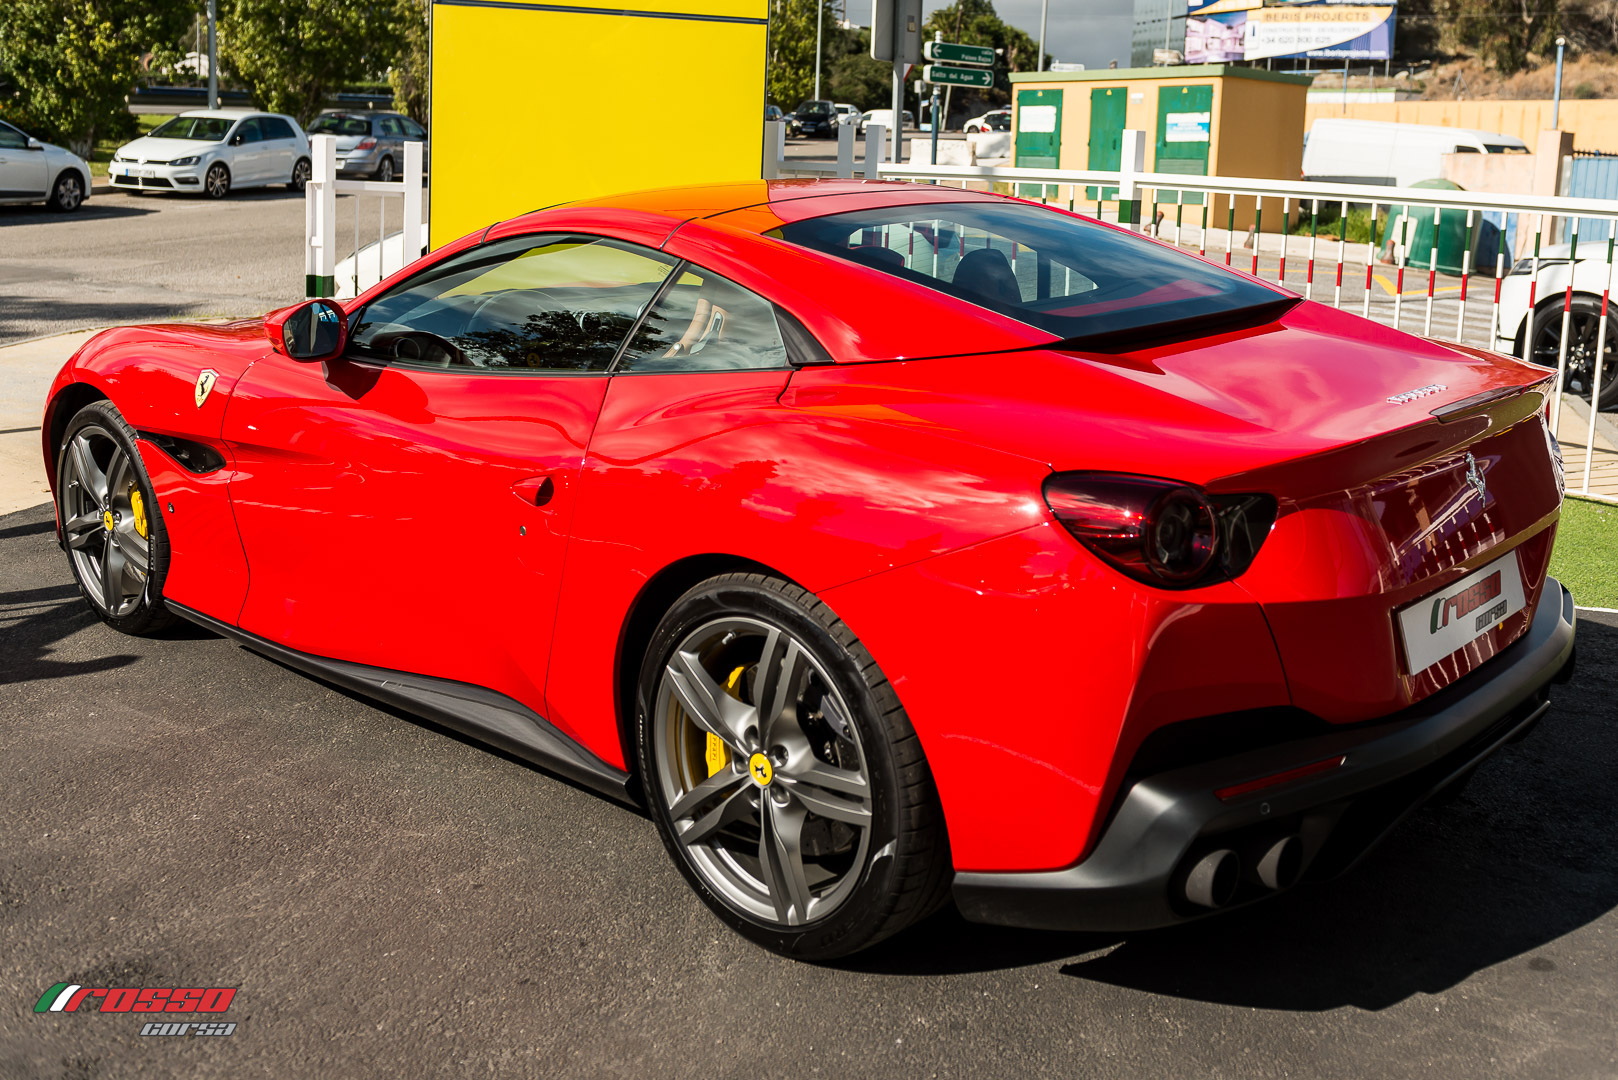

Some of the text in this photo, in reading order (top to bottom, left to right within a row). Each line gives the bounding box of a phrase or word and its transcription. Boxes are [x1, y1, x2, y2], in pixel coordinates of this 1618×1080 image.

[1305, 11, 1370, 21] PROJECTS
[931, 70, 946, 78] Salto
[960, 73, 974, 82] Agua
